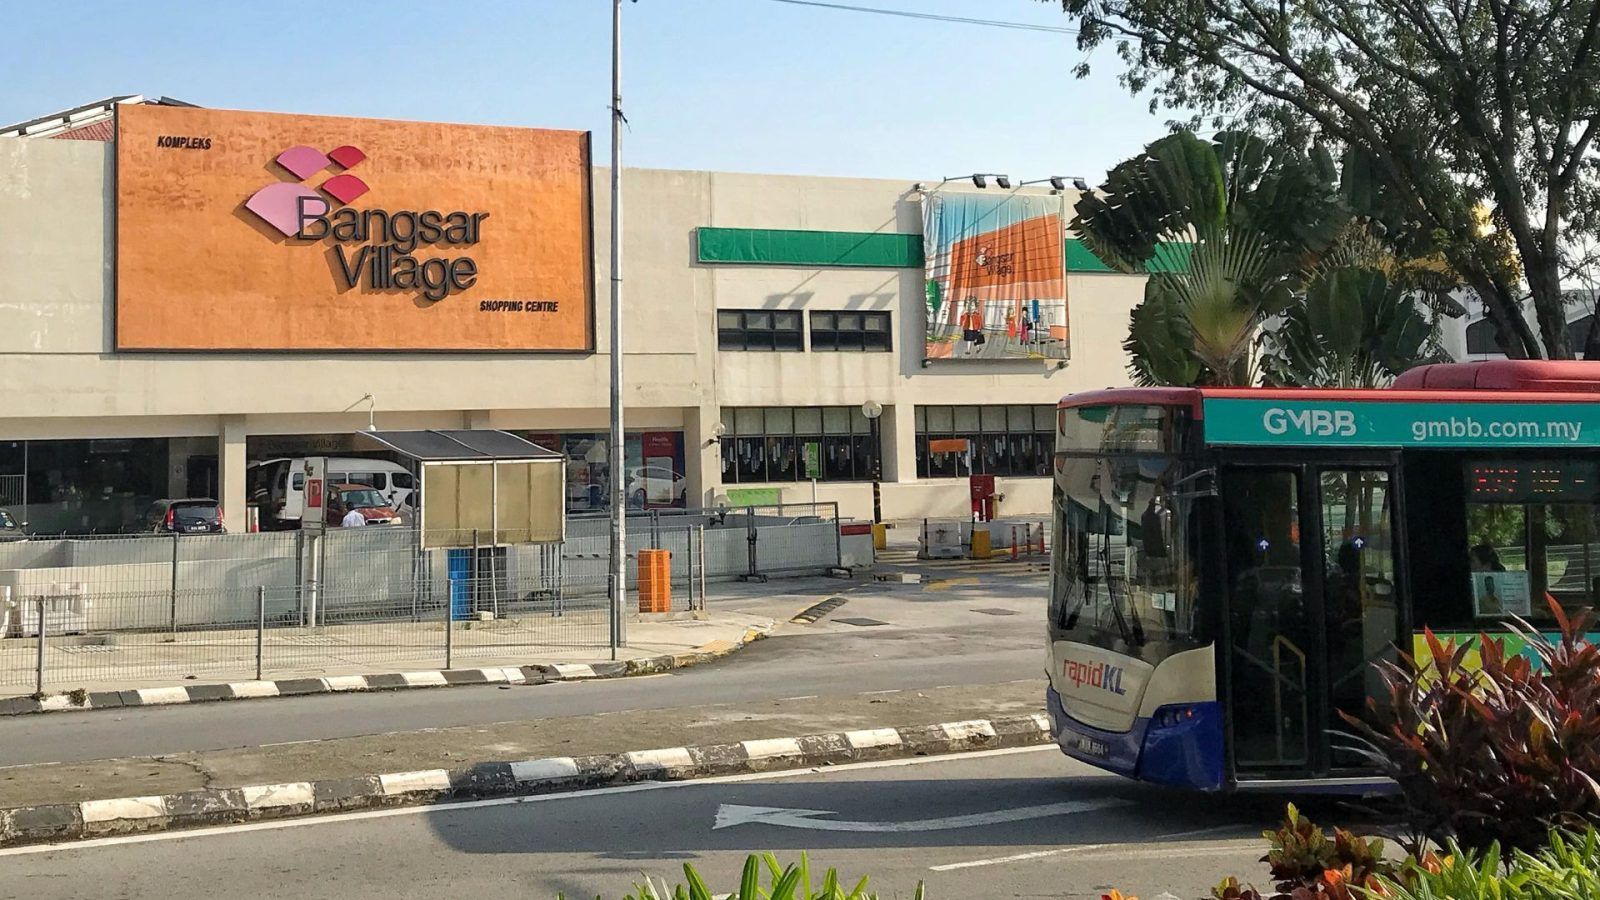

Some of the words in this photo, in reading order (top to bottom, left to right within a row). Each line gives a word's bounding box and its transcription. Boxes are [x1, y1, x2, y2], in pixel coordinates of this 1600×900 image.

[157, 135, 212, 150] KOMPLEKS
[297, 195, 490, 255] Bangsar
[334, 244, 479, 301] Village
[480, 300, 523, 312] SHOPPING
[525, 301, 559, 312] CENTRE
[1263, 408, 1357, 437] GMBB
[1411, 416, 1583, 442] gmbb.com.my
[1063, 659, 1127, 696] rapidKL
